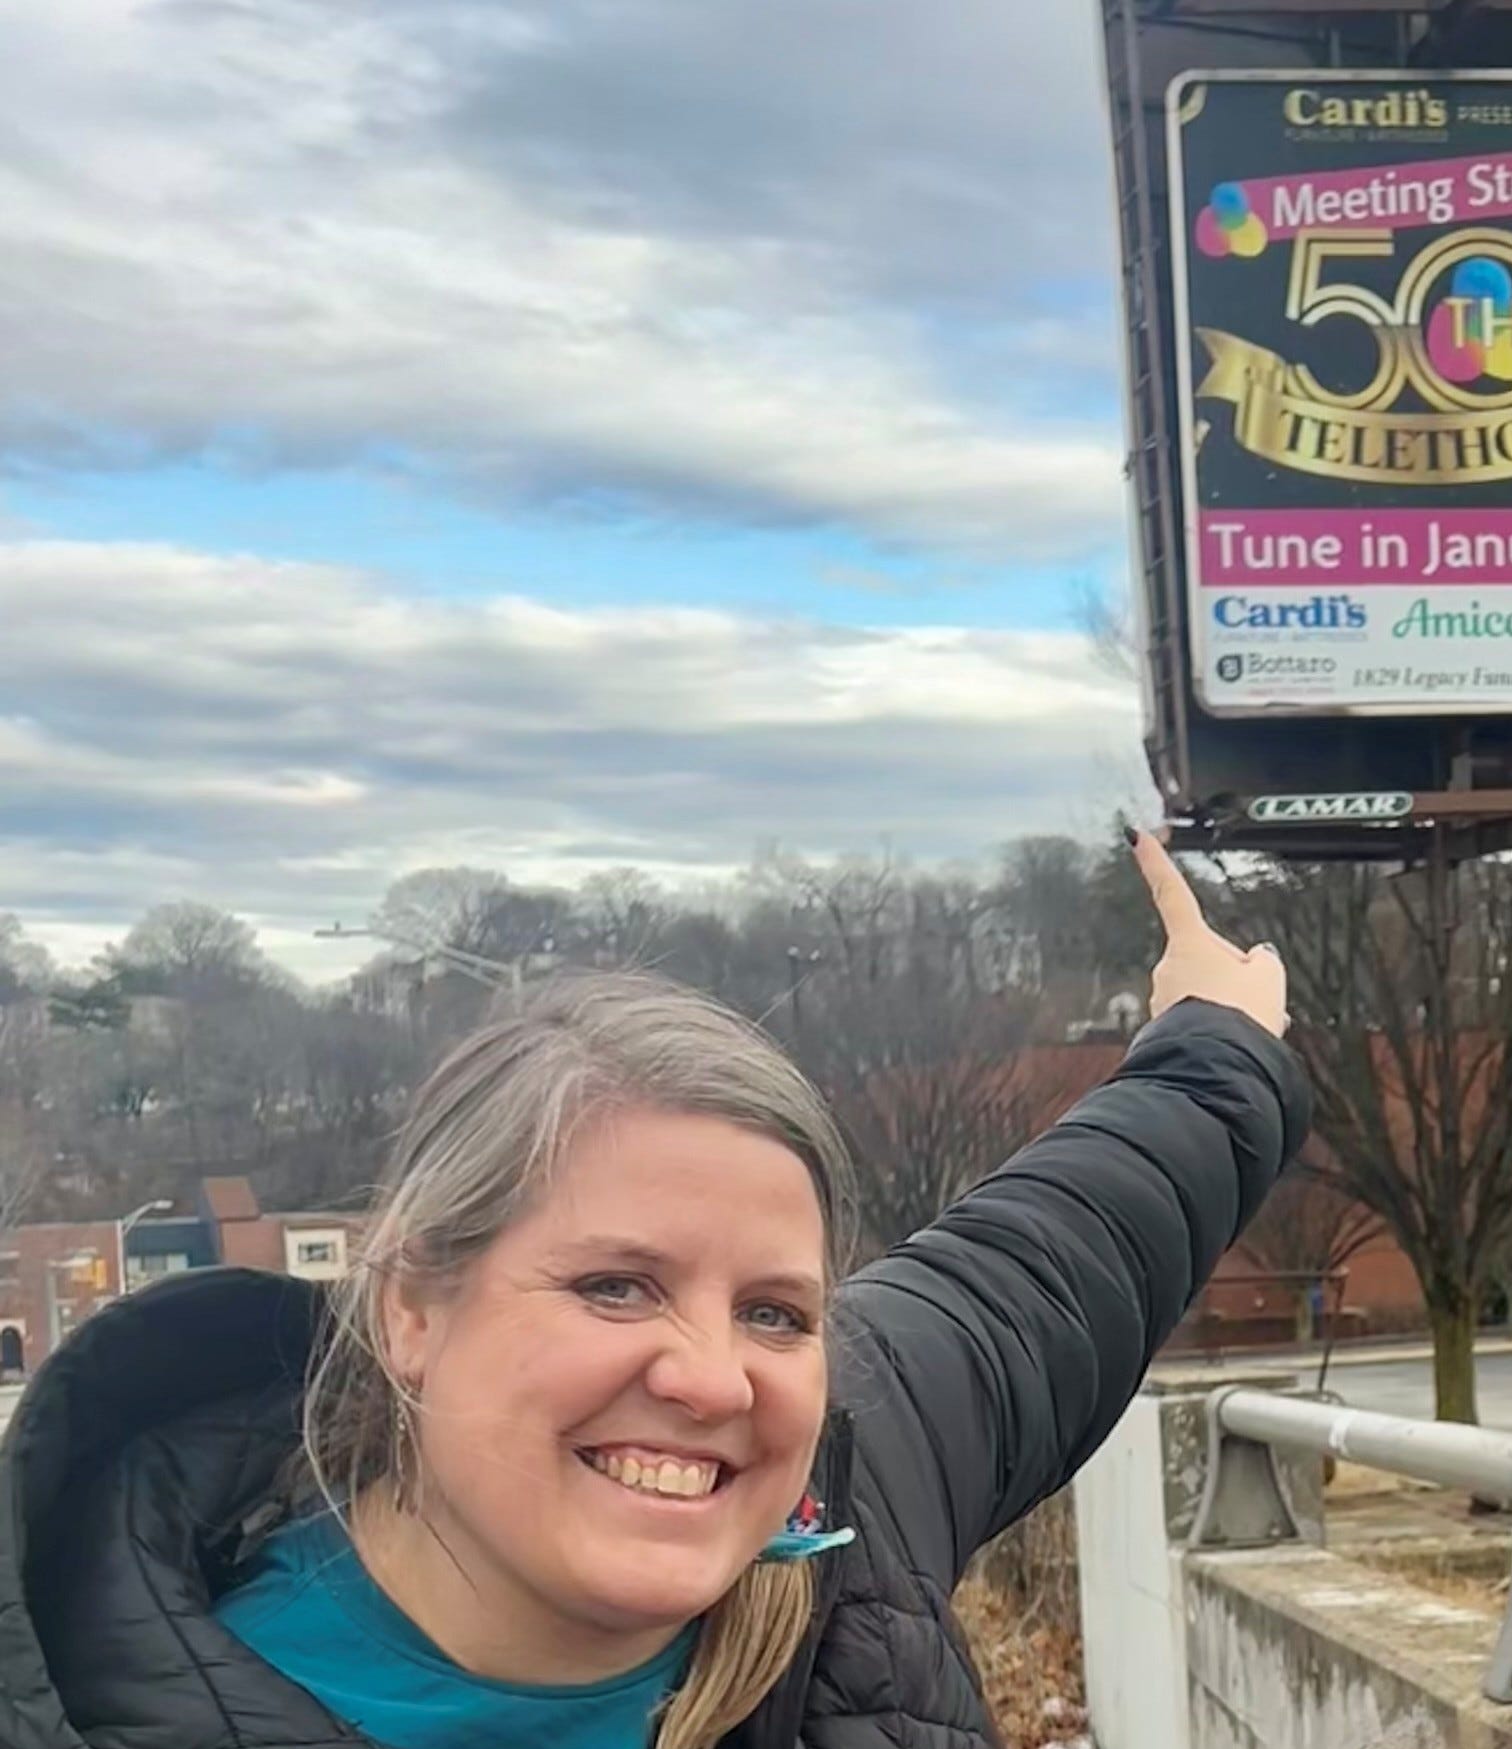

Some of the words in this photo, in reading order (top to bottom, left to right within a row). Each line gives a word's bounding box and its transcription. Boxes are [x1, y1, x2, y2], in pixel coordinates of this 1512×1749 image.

[1284, 88, 1448, 127] Cardi's
[1272, 171, 1455, 228] Meeting
[1208, 524, 1343, 569] Tune
[1361, 523, 1408, 567] in
[1213, 595, 1367, 630] Cardi's
[1248, 653, 1337, 675] Bottaro
[1404, 669, 1467, 690] Legacy
[1261, 797, 1399, 817] LAMAR
